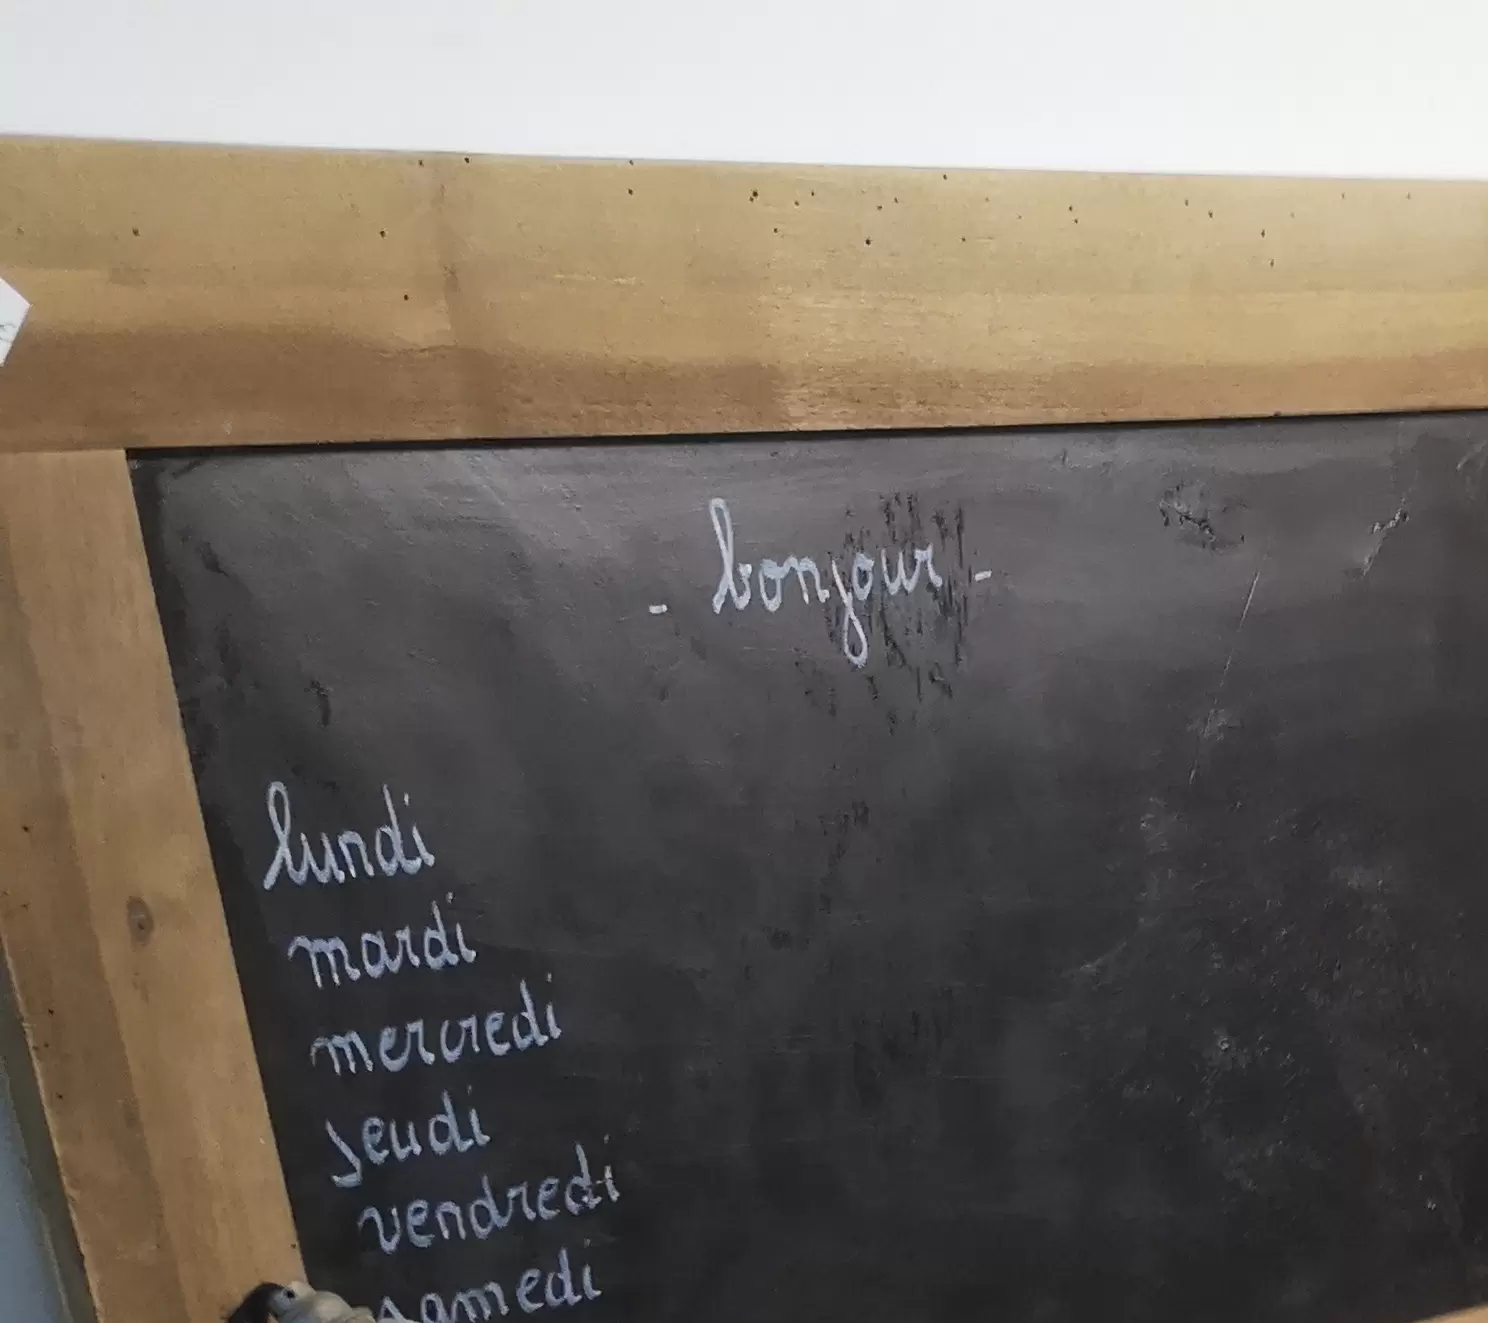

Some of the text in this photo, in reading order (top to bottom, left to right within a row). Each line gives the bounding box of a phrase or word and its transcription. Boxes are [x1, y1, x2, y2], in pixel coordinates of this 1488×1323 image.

[709, 498, 943, 668] bonjour
[263, 780, 435, 890] lundi
[286, 891, 477, 989] mardi
[310, 972, 562, 1075] mercredi
[358, 1135, 620, 1254] vendredi
